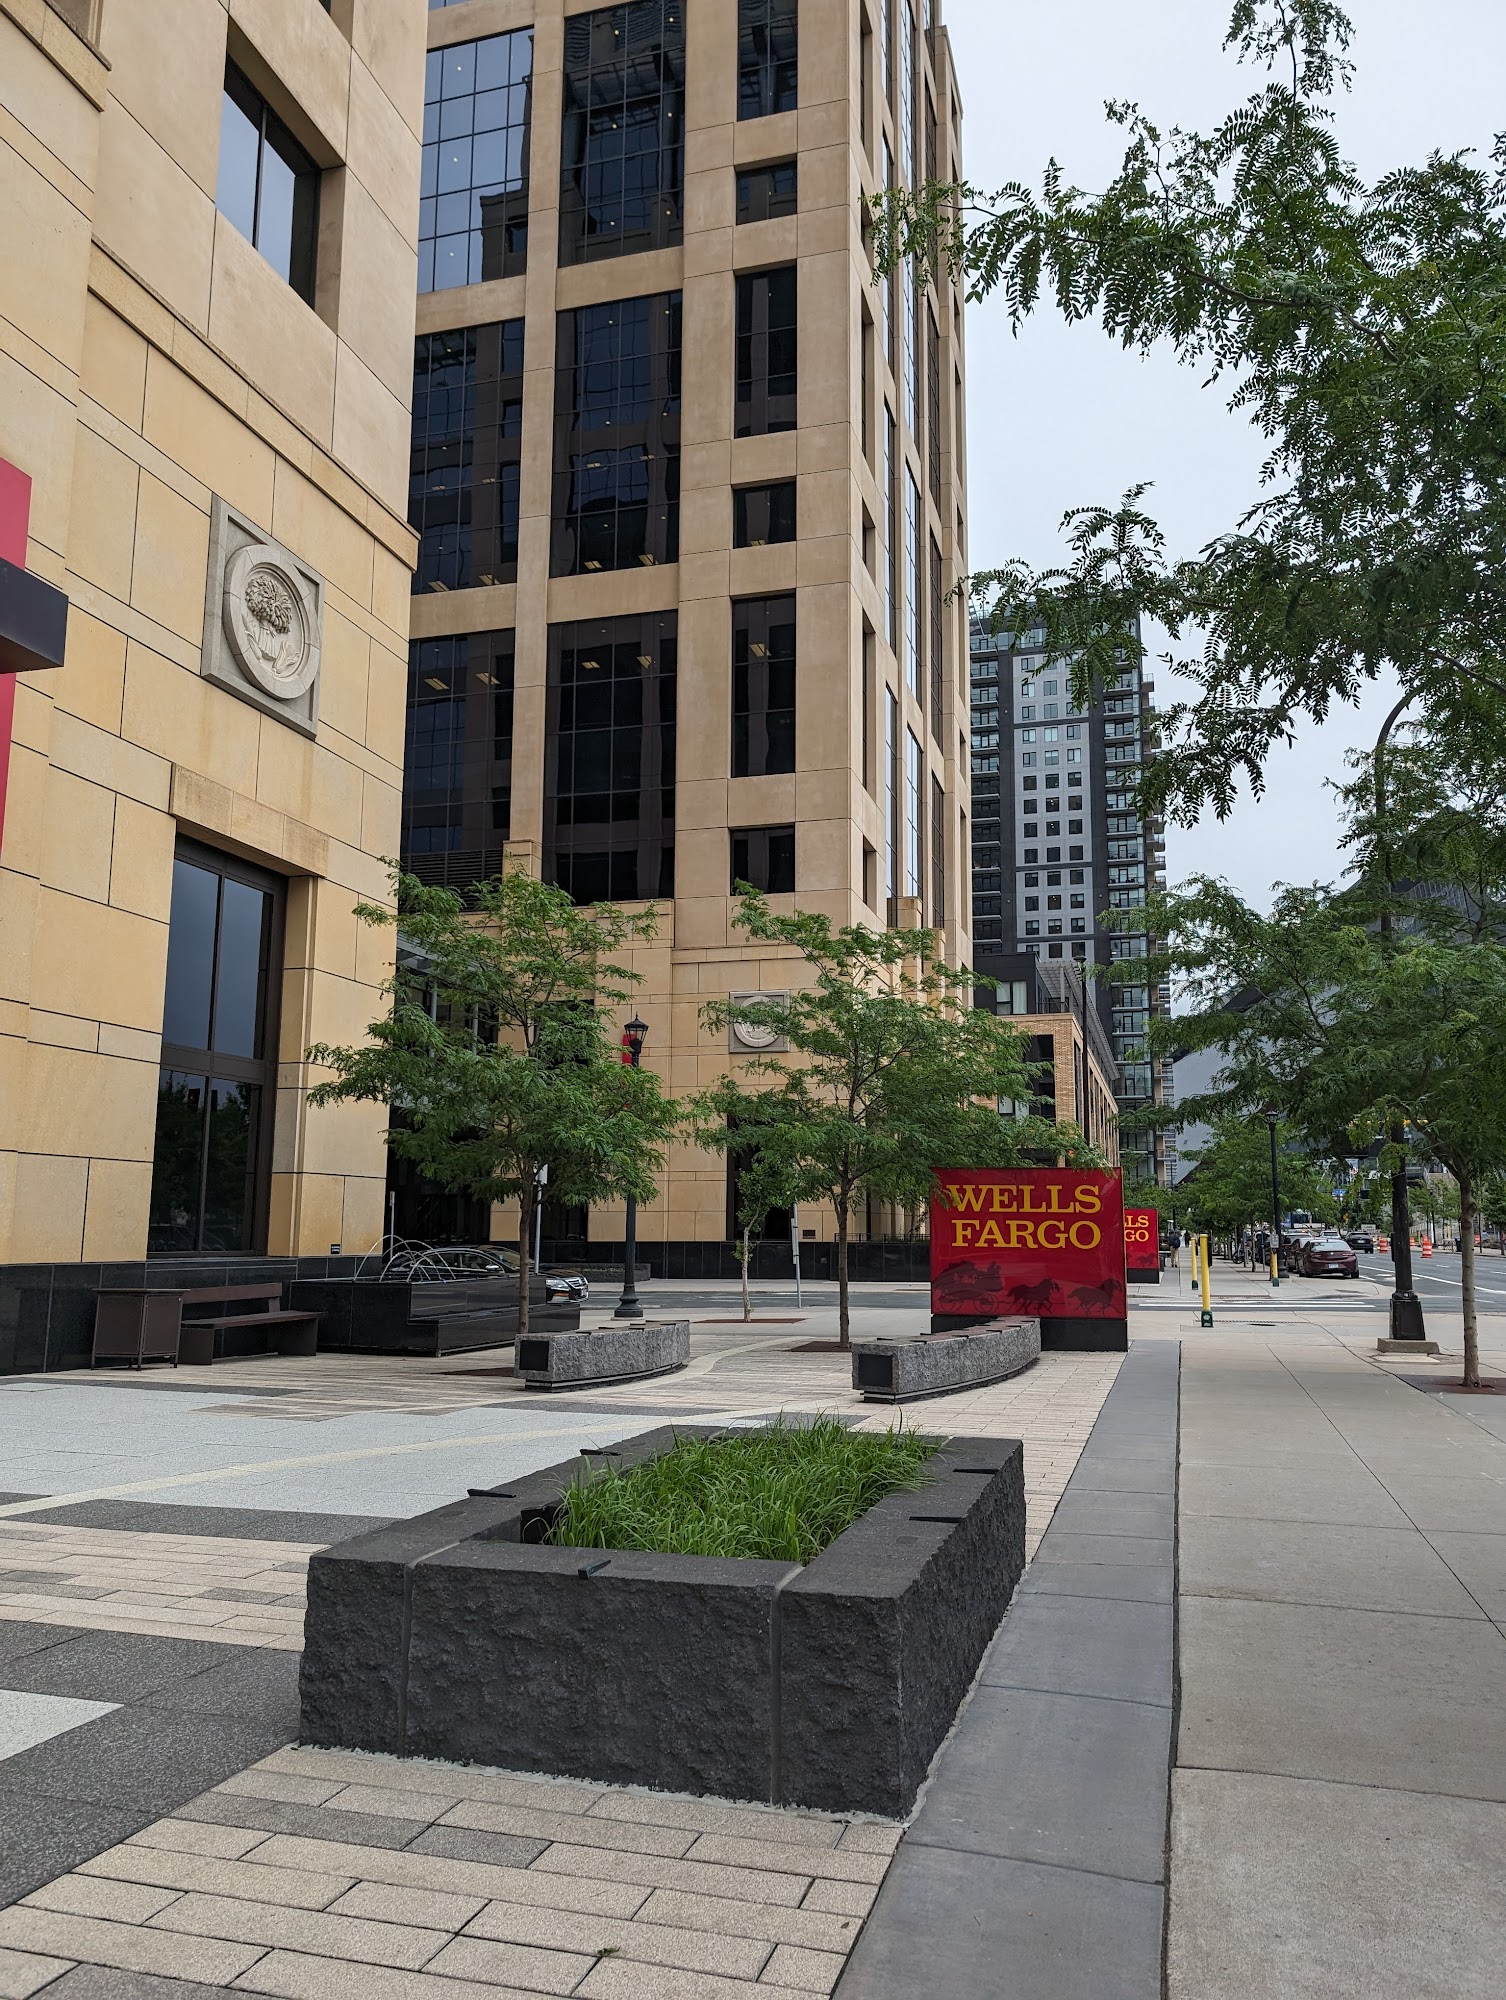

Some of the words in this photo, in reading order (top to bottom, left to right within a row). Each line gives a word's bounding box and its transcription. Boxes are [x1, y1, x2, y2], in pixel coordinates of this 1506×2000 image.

[946, 1184, 1101, 1213] WELLS
[951, 1219, 1101, 1249] FARGO
[1124, 1215, 1149, 1228] LS
